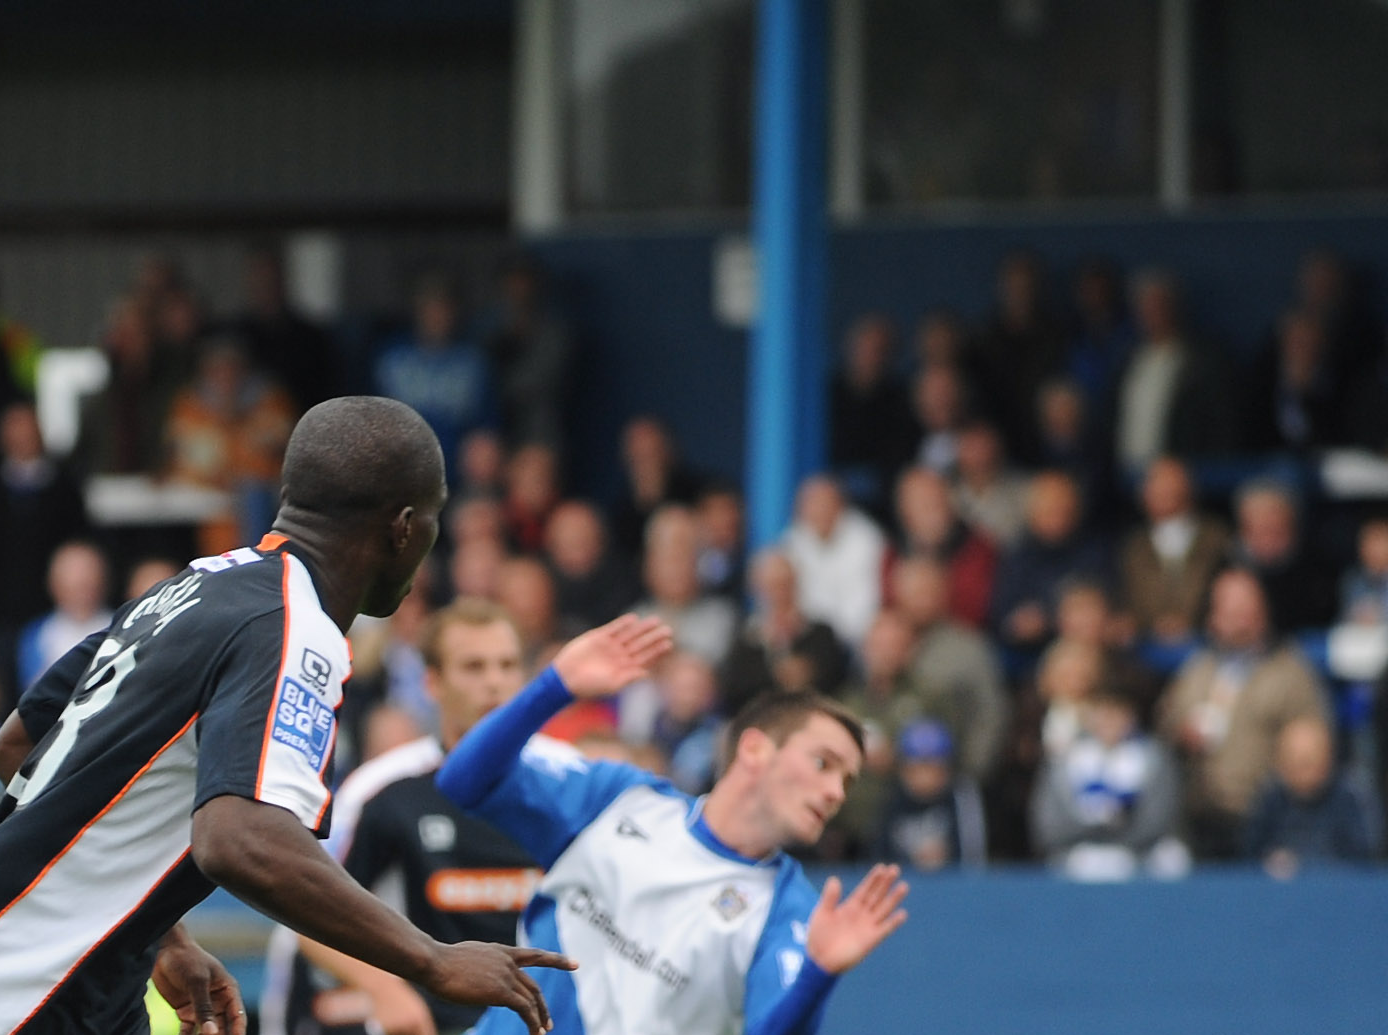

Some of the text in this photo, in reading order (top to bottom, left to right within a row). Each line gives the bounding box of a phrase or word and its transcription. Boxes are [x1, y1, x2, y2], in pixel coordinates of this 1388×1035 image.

[278, 702, 313, 736] SQ
[283, 682, 332, 729] BLUE
[273, 726, 320, 768] PREMR
